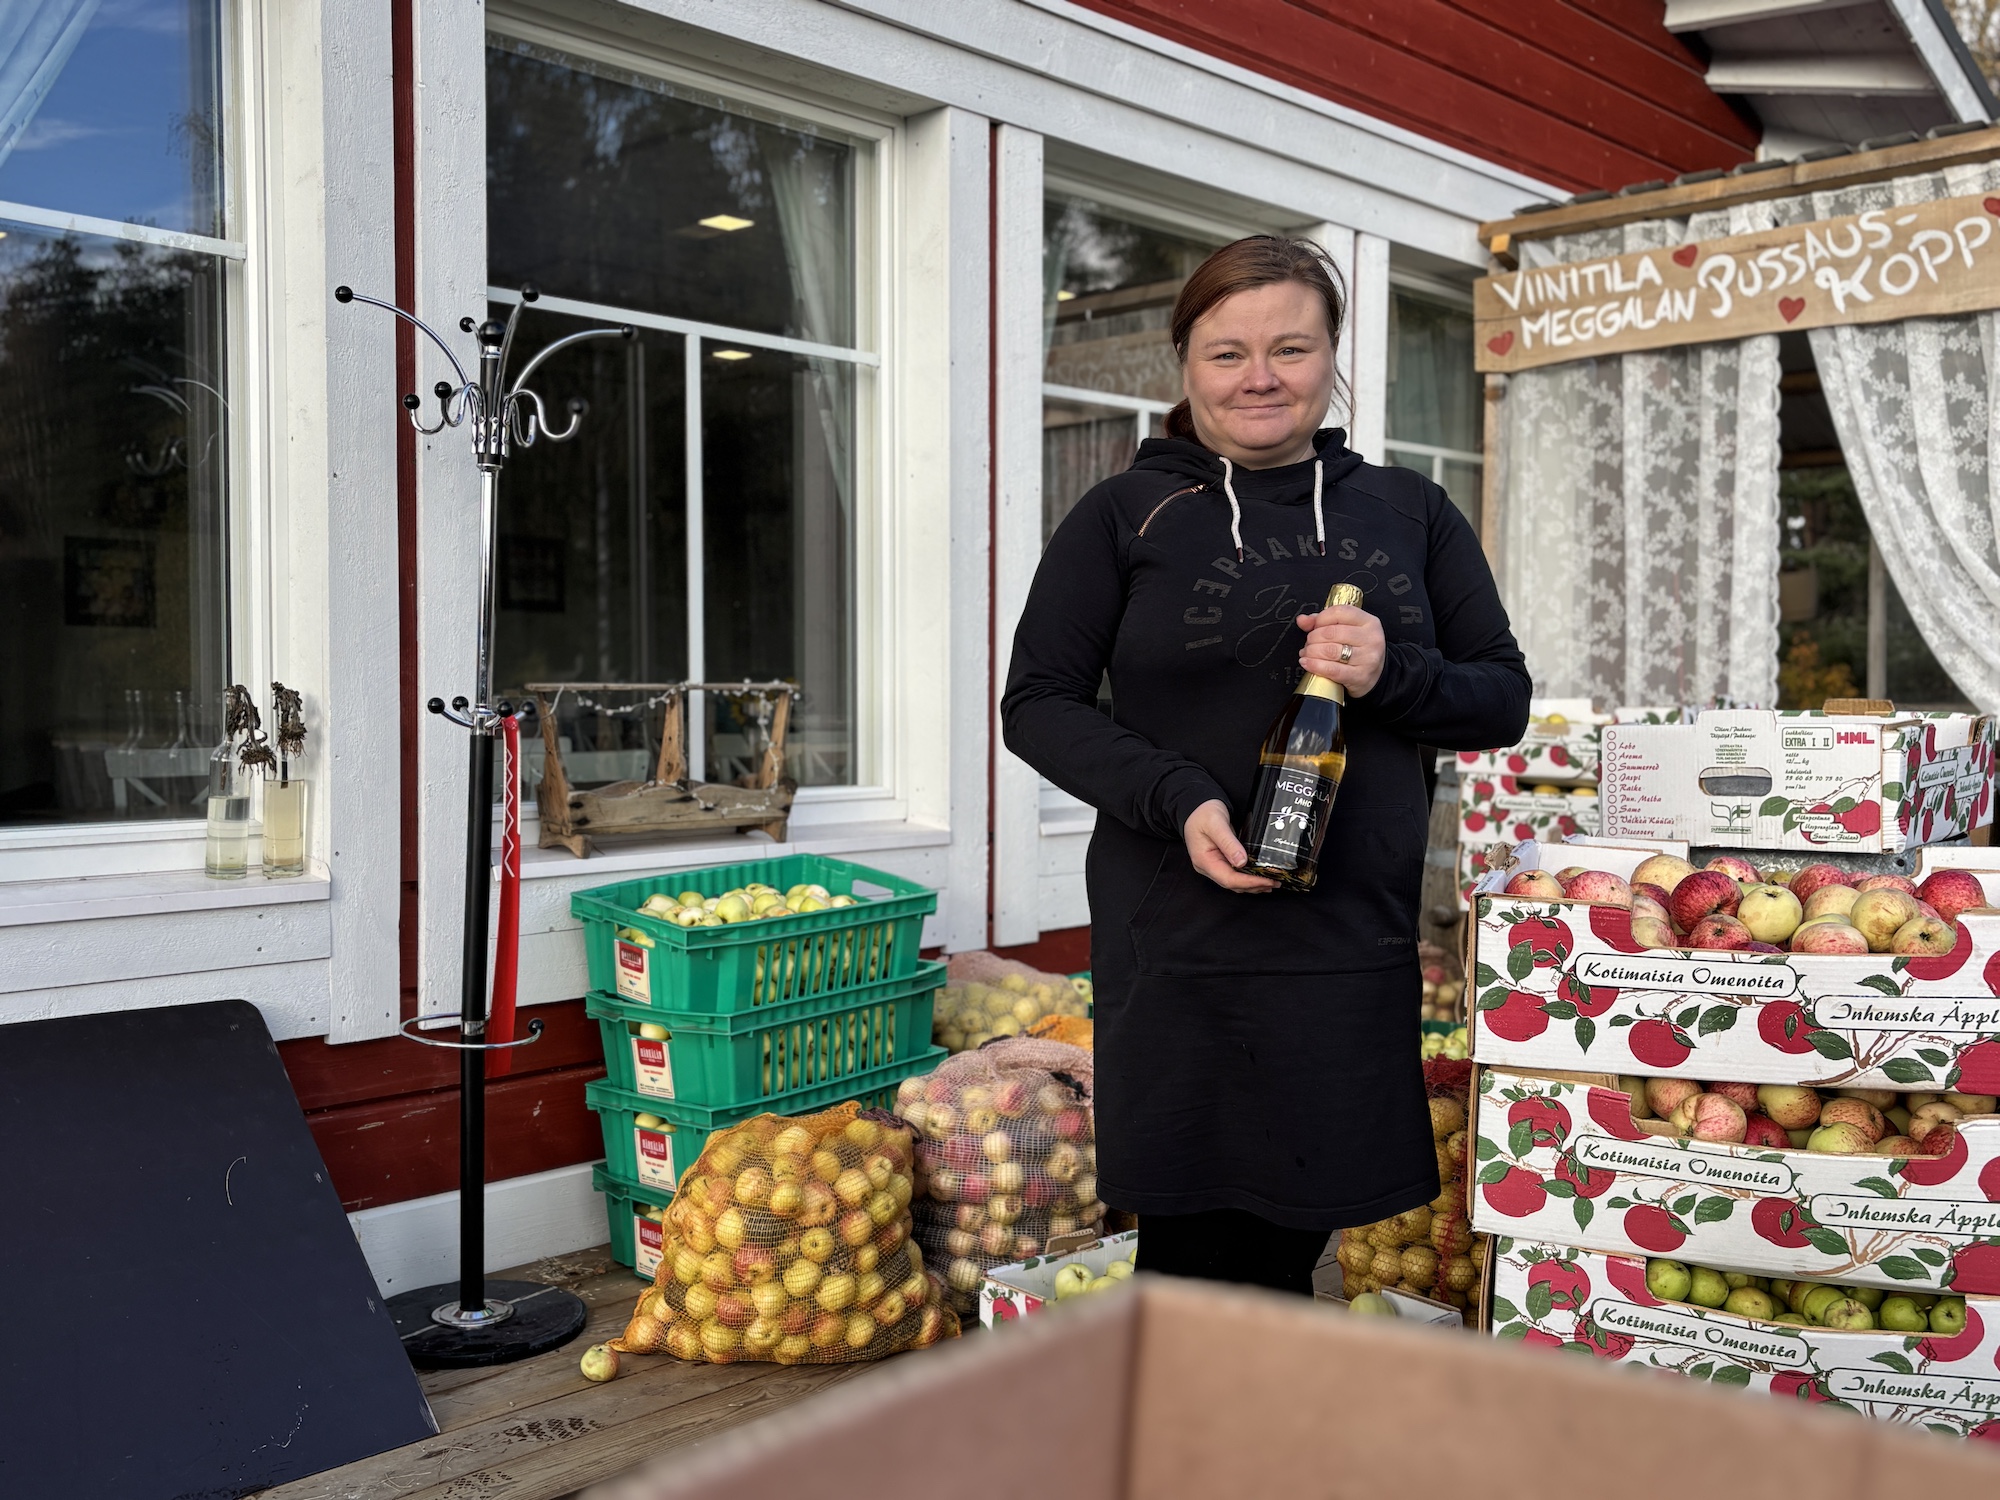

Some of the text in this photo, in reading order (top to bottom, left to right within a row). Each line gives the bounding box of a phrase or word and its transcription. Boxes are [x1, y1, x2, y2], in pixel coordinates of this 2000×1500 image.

[1814, 216, 2000, 315] KOPP
[1493, 256, 1663, 311] VIINITILA
[1521, 286, 1697, 349] MEGGALAN
[1338, 537, 1424, 646] SPOR
[1618, 742, 1636, 750] Lobo
[1785, 738, 1830, 747] EXTRA I II
[1836, 732, 1875, 744] HML
[1618, 752, 1643, 760] Aroma
[1618, 762, 1660, 771] Summerred
[1619, 773, 1641, 783] Jaspi
[1275, 780, 1330, 804] MEGGALA
[1620, 784, 1642, 792] Raike
[1637, 795, 1662, 803] Melba
[1618, 805, 1641, 814] Samo
[1620, 827, 1655, 837] Discovery
[1812, 832, 1831, 840] Suomi
[1584, 962, 1785, 989] Kotimaisia Omenoita
[1829, 1003, 1935, 1023] Inhemska
[1582, 1143, 1780, 1186] Kotimaisia Omenoita
[1825, 1202, 1932, 1224] Inhemska
[1599, 1307, 1797, 1360] Kotimaisia Omenoita
[1841, 1376, 1946, 1400] Inhemska
